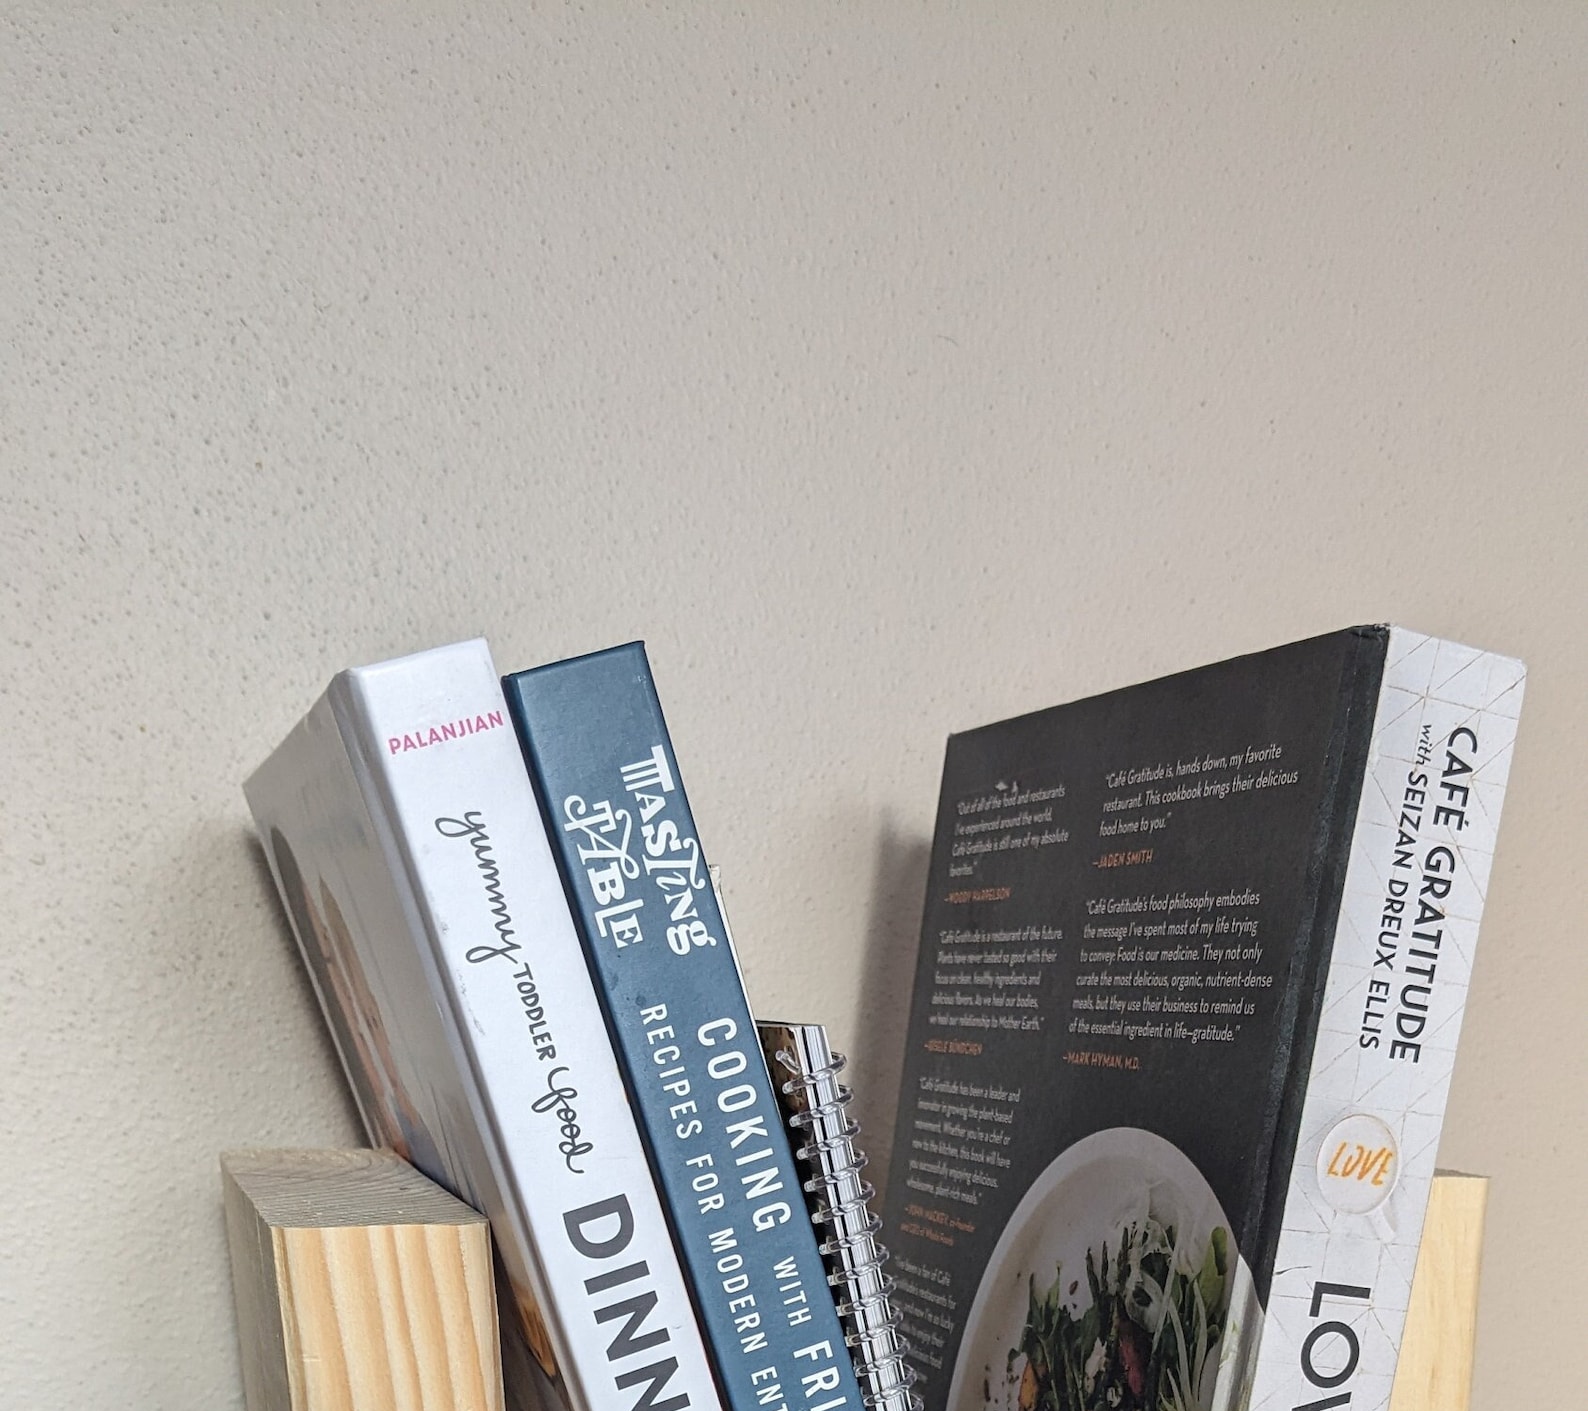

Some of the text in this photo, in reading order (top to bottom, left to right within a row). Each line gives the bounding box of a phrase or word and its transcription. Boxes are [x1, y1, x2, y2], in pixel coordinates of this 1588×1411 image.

[388, 710, 505, 756] PALANJIAN
[1127, 763, 1164, 785] Gratitude
[1176, 757, 1201, 775] hands
[1245, 743, 1282, 763] favorite
[1145, 789, 1161, 806] This
[1162, 781, 1202, 803] cookbook
[1203, 780, 1230, 799] brings
[1232, 774, 1254, 792] their
[1255, 769, 1298, 789] delicious
[1099, 820, 1118, 836] food
[1117, 819, 1139, 834] home
[1126, 849, 1153, 865] SMITH
[1149, 894, 1169, 911] food
[1168, 891, 1215, 914] philosophy
[1216, 888, 1260, 907] embodies
[1360, 723, 1432, 1050] with SEIZAN DREUX ELLIS
[1389, 727, 1478, 1063] CAFÉ GRATITUDE
[1097, 927, 1128, 941] message
[1144, 921, 1166, 940] spent
[1167, 920, 1188, 935] most
[1215, 916, 1229, 933] life
[1231, 917, 1258, 937] trying
[1117, 946, 1137, 961] Food
[1203, 943, 1224, 964] They
[1242, 942, 1263, 964] only
[435, 811, 593, 1175] yummy TODDLER food
[1076, 972, 1099, 986] curate
[1113, 972, 1132, 986] most
[1205, 970, 1272, 987] nutrient-dense
[1109, 995, 1126, 1014] they
[1142, 996, 1161, 1012] their
[1162, 996, 1198, 1013] business
[1210, 997, 1244, 1014] remind
[1091, 1020, 1124, 1035] essential
[1124, 1021, 1163, 1040] ingredient
[640, 1002, 703, 1139] RECIPES
[686, 1153, 725, 1216] FOR
[708, 1226, 769, 1354] MODERN
[697, 1017, 791, 1233] COOKING
[773, 1255, 812, 1328] WITH
